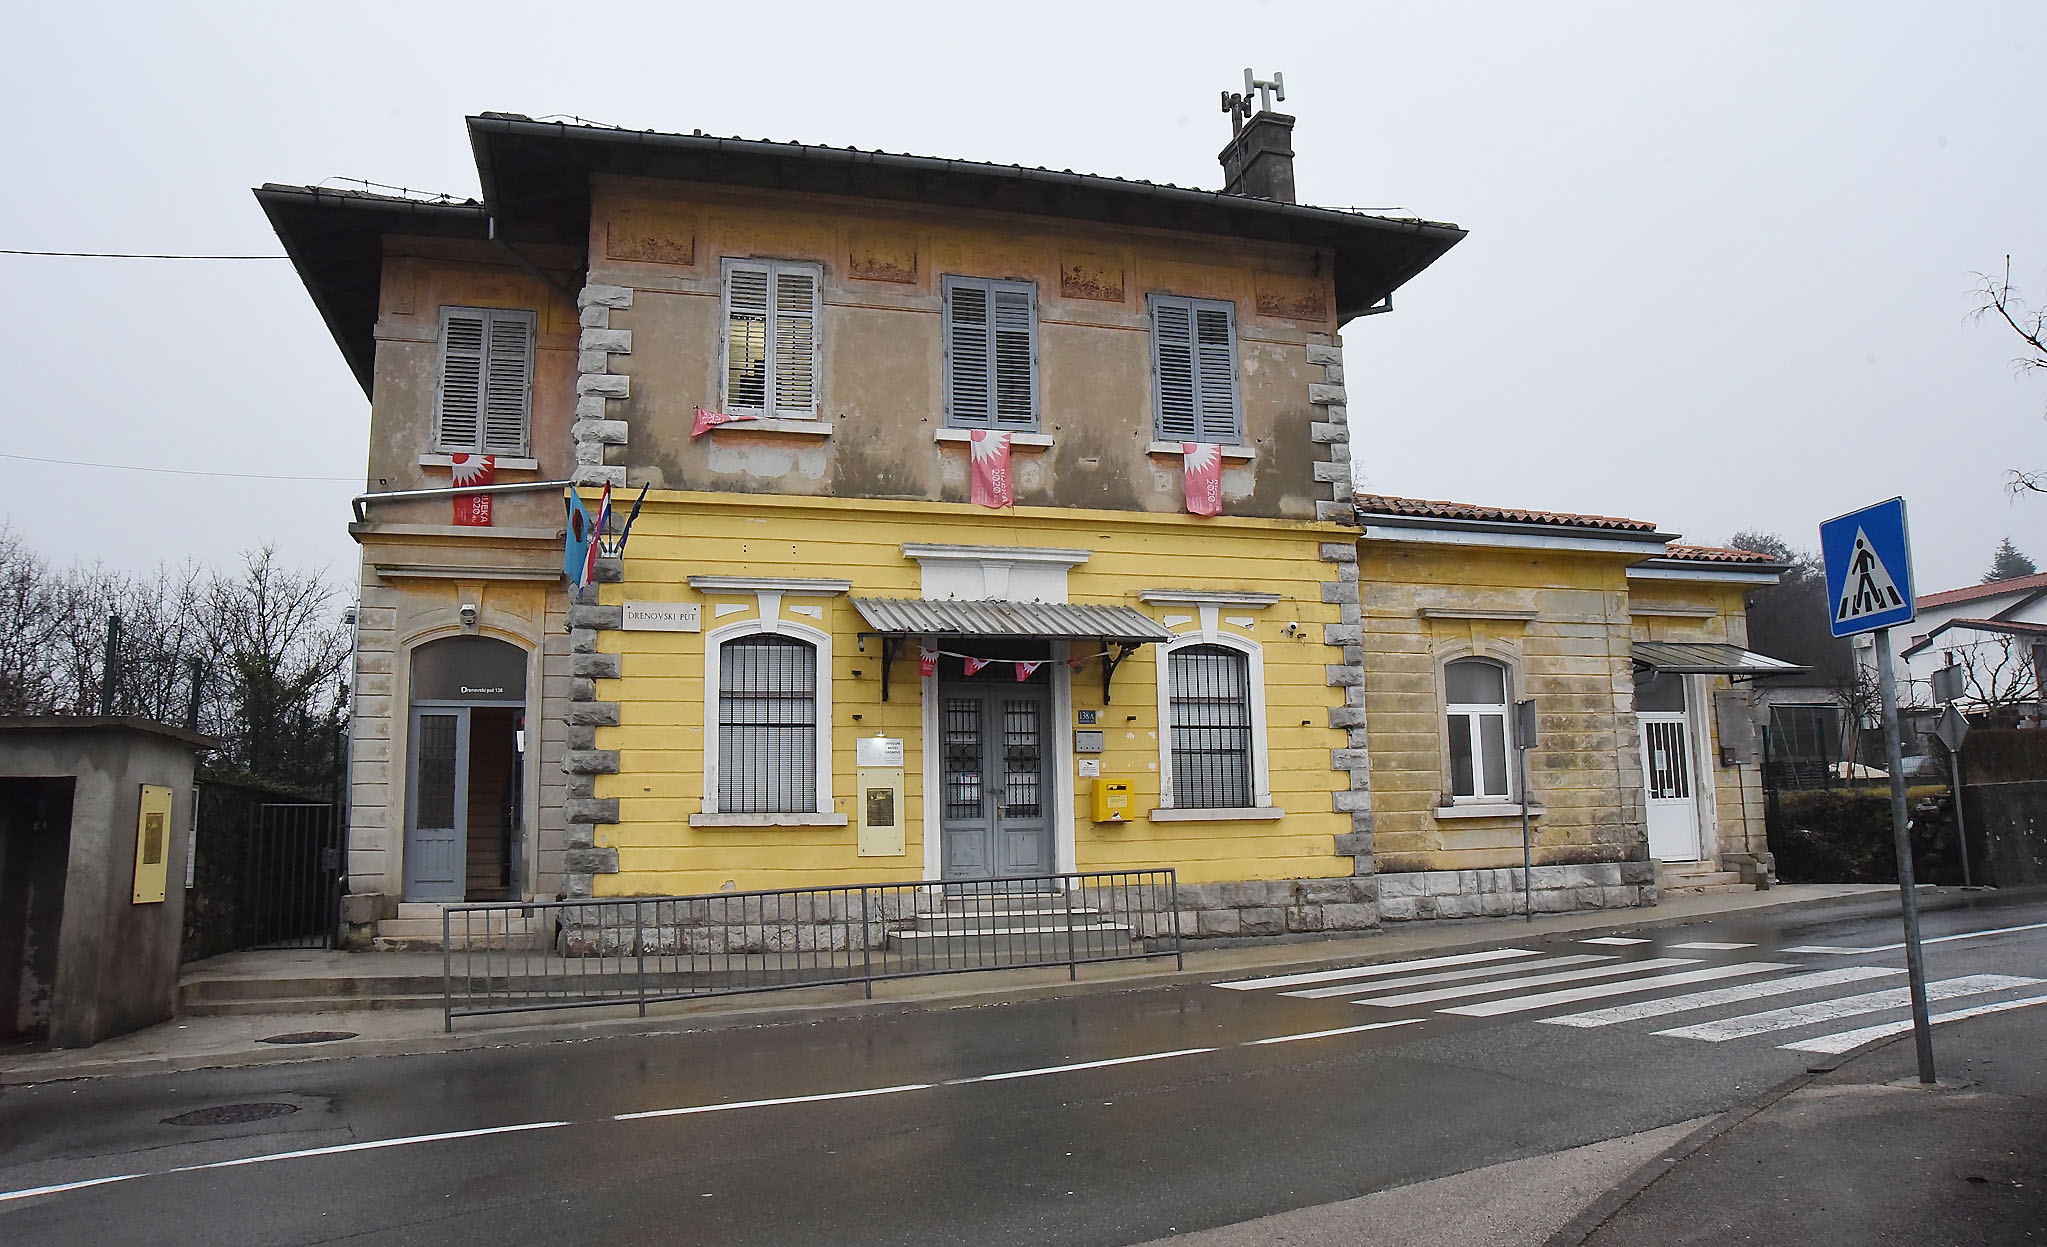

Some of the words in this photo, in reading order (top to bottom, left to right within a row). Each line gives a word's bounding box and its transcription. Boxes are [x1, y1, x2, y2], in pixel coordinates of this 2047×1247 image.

[991, 468, 1001, 494] 2020
[1206, 478, 1216, 503] 2020
[628, 611, 676, 621] DRENOVSKI
[680, 613, 696, 621] PUT
